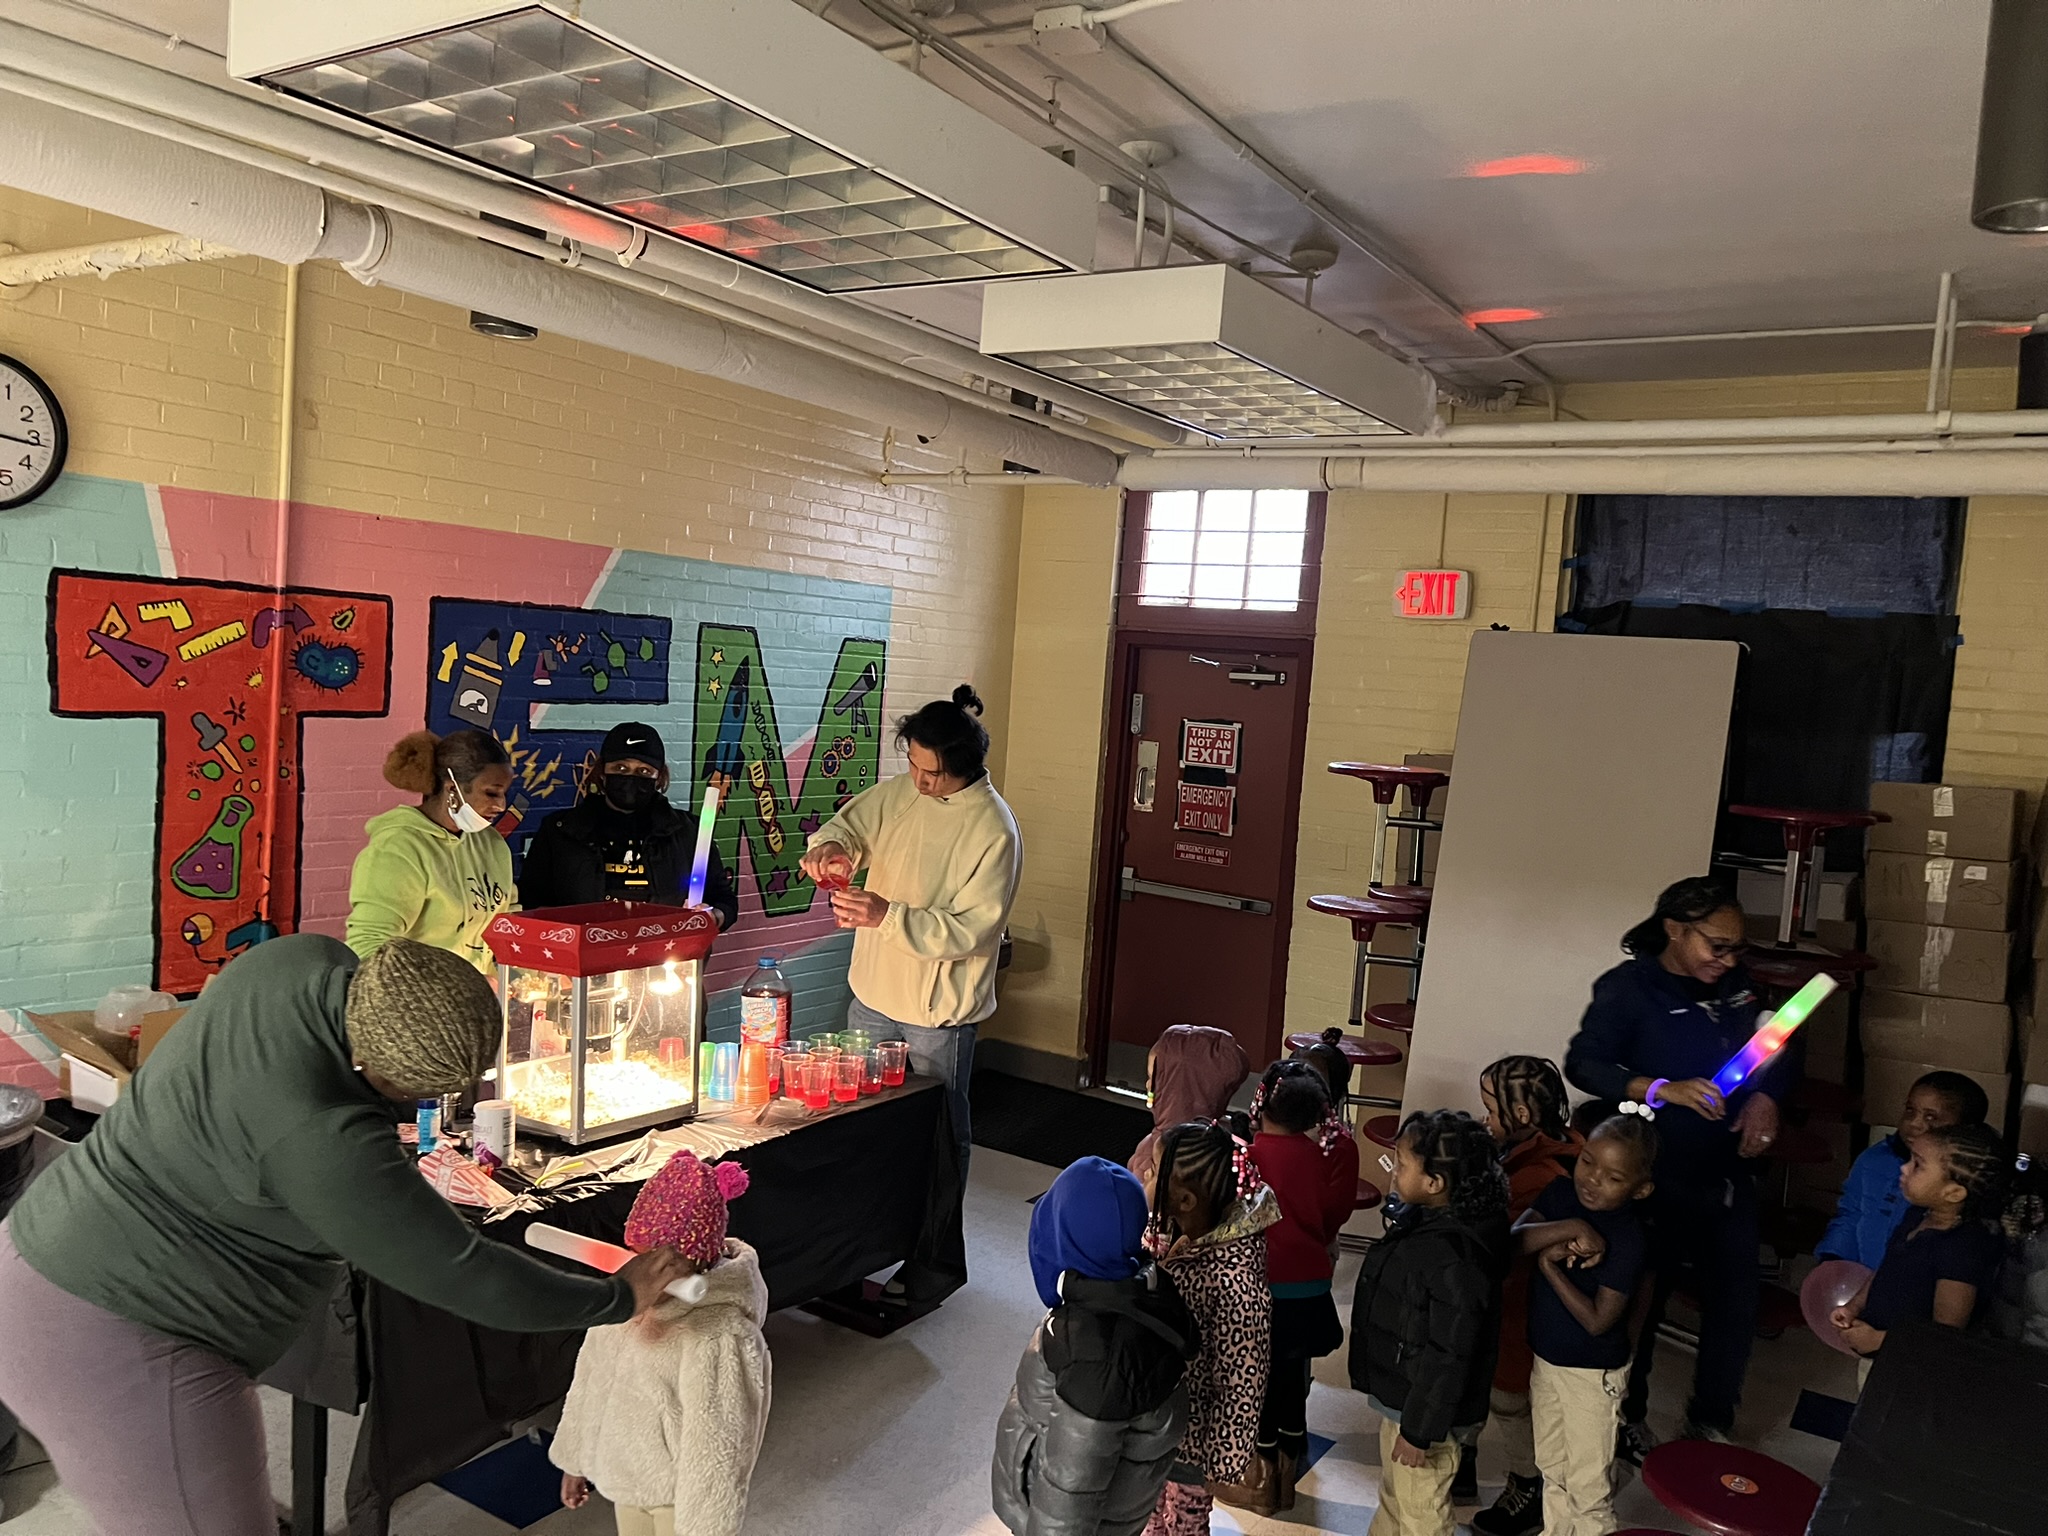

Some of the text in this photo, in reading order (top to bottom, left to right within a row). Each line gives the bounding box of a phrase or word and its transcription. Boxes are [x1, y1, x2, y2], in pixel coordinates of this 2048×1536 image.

[4, 383, 12, 401] 1
[20, 405, 34, 423] 2
[27, 429, 41, 446] 3
[18, 454, 33, 471] 4
[0, 469, 14, 487] 5
[1403, 571, 1461, 616] EXIT
[1190, 727, 1232, 740] THIS IS
[1189, 737, 1231, 749] NOT AN
[1187, 746, 1231, 765] EXIT
[1181, 786, 1230, 808] EMERGENCY
[1184, 809, 1222, 831] EXIT ONLY
[1176, 843, 1229, 858] EMERGENCY EXIT ONLY
[1180, 852, 1196, 860] ALARM
